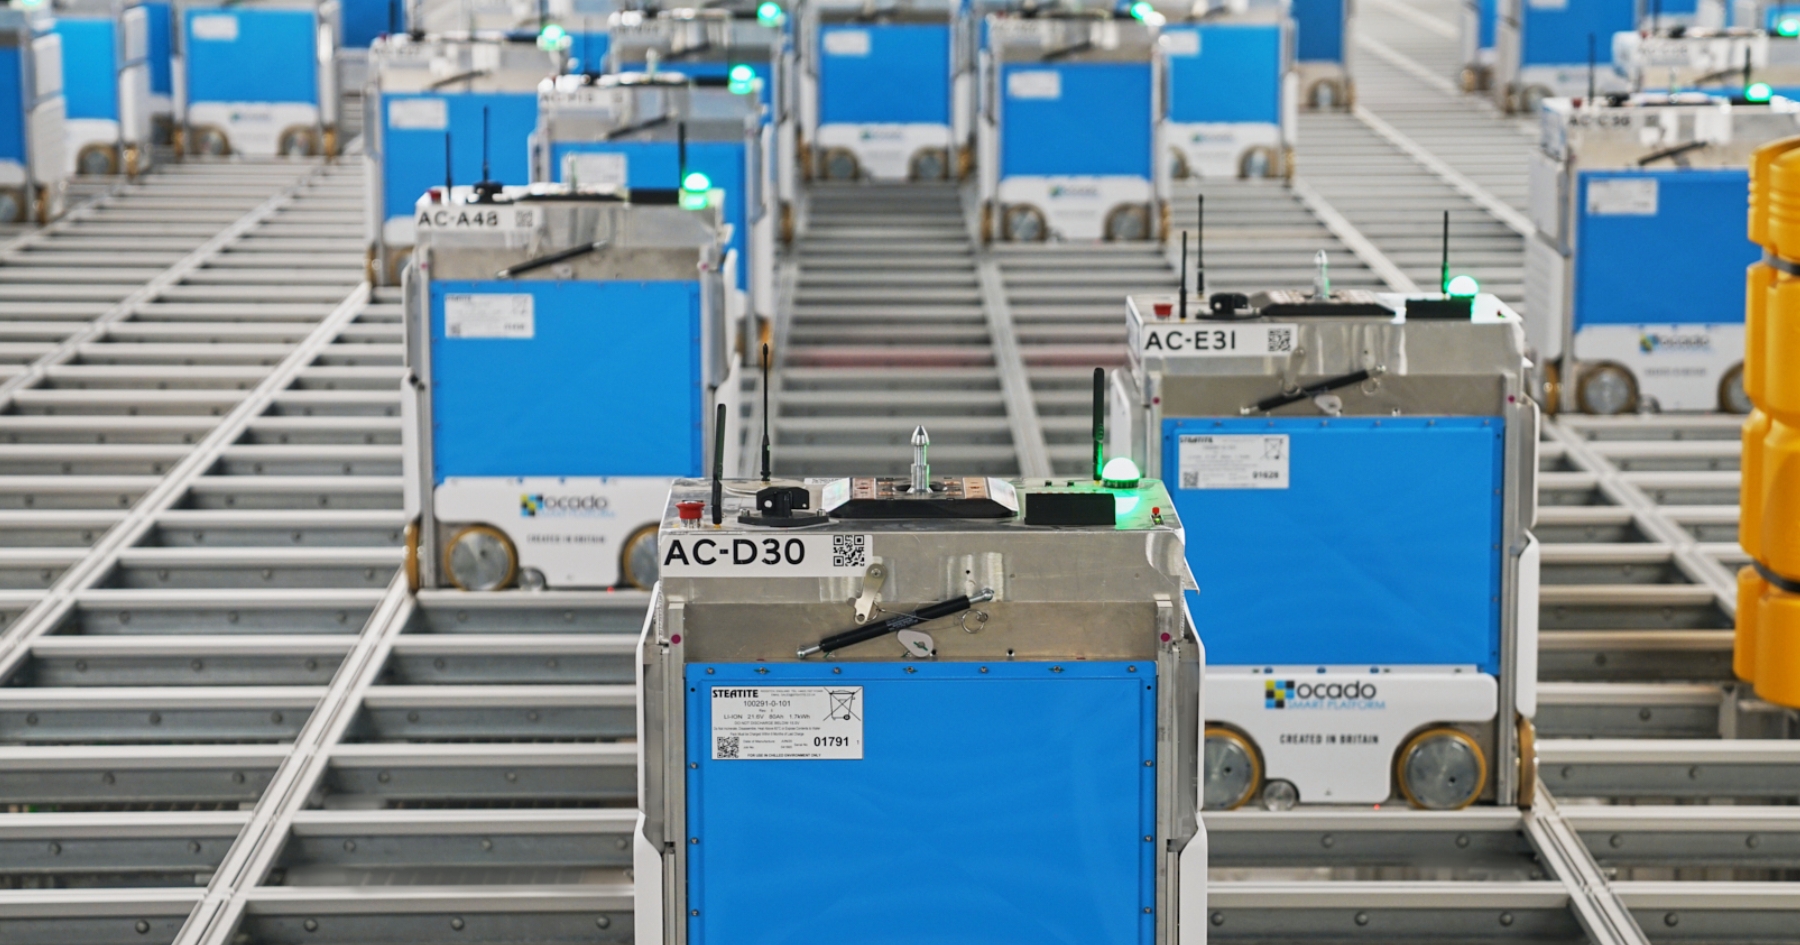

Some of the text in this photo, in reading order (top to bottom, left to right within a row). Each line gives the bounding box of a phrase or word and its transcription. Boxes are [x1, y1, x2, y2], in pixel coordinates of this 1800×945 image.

[418, 210, 498, 226] AC-A48
[1145, 330, 1236, 350] AC-E31
[544, 494, 608, 509] ocado
[664, 538, 806, 565] AC-D30
[712, 690, 758, 698] STEATITE
[1297, 680, 1376, 699] ocado
[1287, 700, 1386, 709] SMART PLATFORM
[814, 737, 848, 746] 01791
[1280, 734, 1378, 744] CREATED IN BRITAIN
